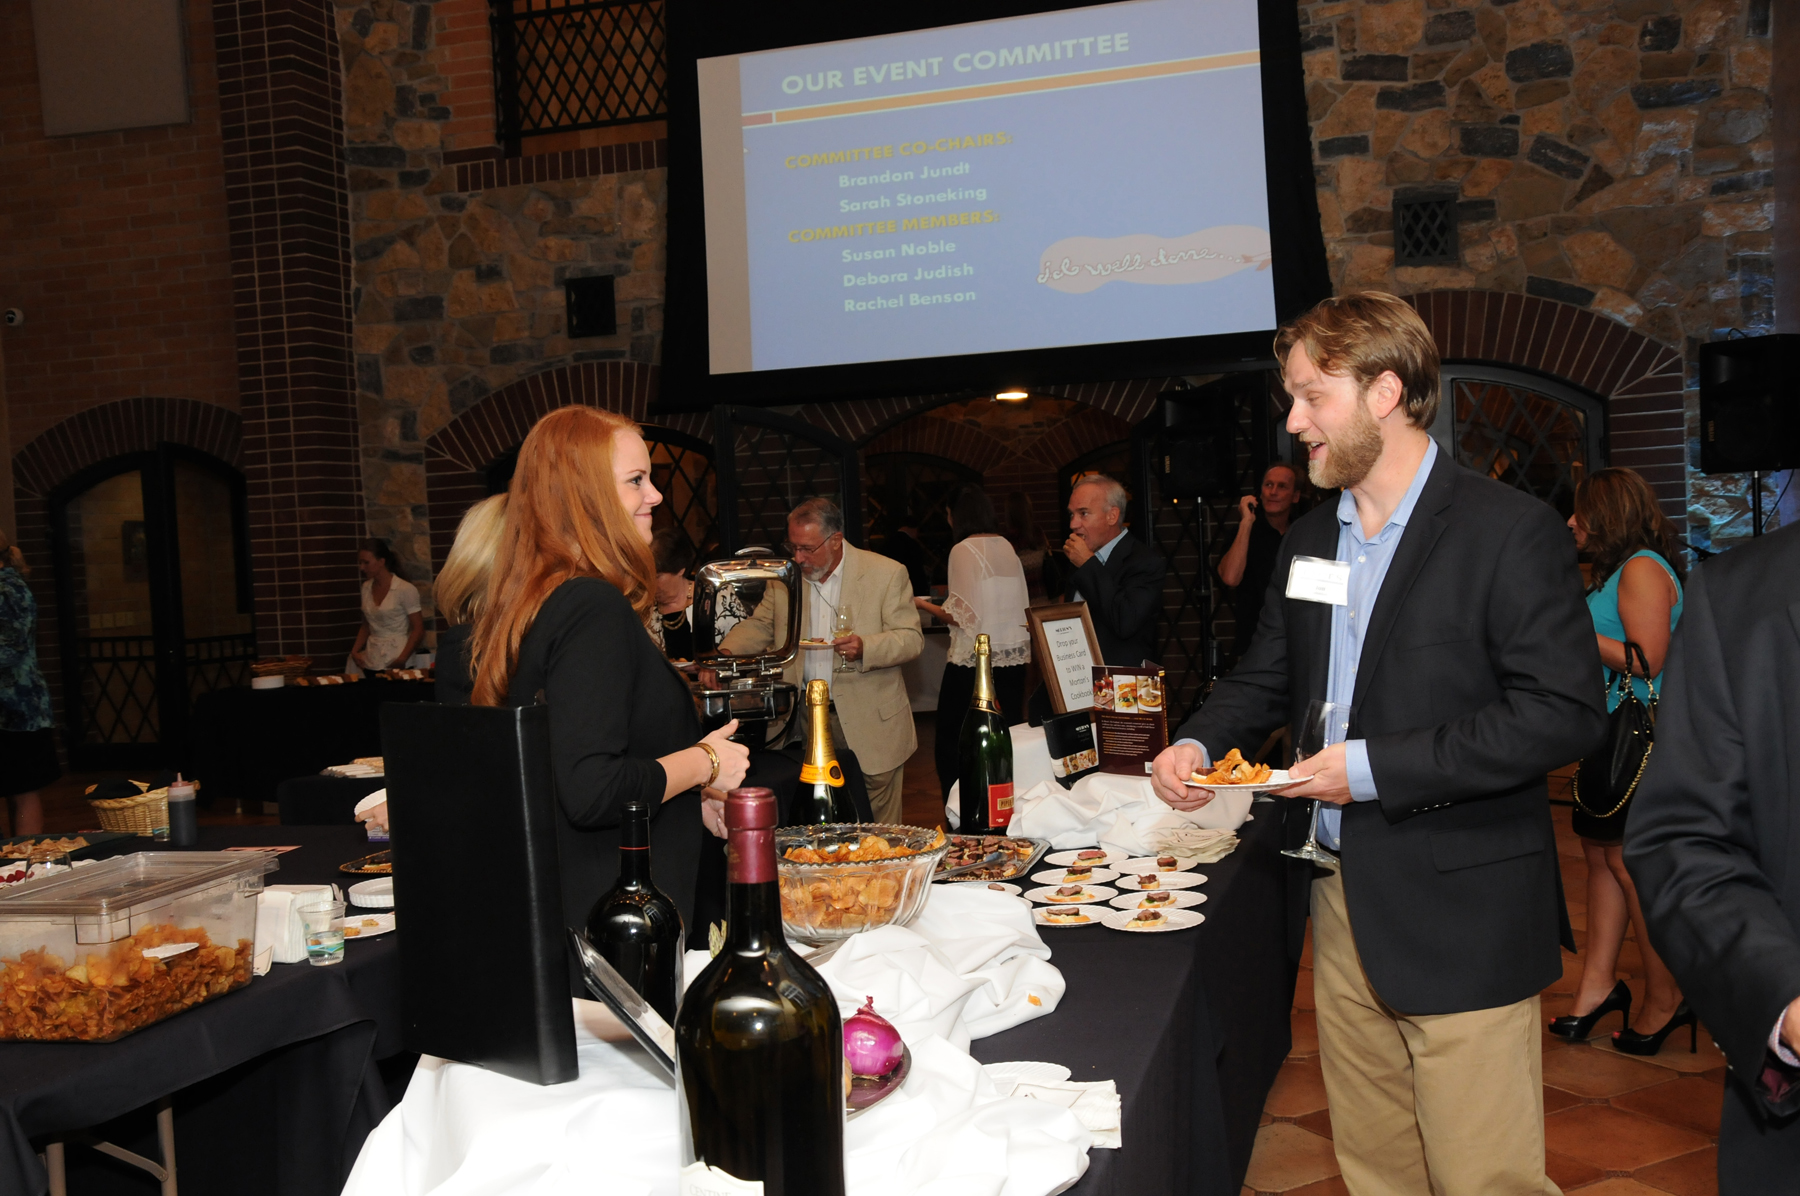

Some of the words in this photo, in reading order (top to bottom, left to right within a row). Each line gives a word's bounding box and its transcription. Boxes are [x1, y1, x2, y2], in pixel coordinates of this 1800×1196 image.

[781, 70, 844, 95] OUR
[853, 57, 944, 86] EVENT
[952, 32, 1131, 73] COMMITTEE
[785, 145, 894, 169] COMMITTEE
[900, 131, 1014, 156] CO-CHAIRS:
[838, 170, 914, 188] Brandon
[920, 162, 971, 180] Jundt
[839, 195, 891, 213] Sarah
[896, 187, 987, 207] Stoneking
[788, 220, 897, 243] COMMITTEE
[902, 209, 1001, 232] MEMBERS:
[842, 248, 896, 263] Susan
[901, 239, 957, 257] Noble
[843, 272, 908, 287] Debora
[913, 263, 974, 281] Judish
[1085, 253, 1144, 276] well
[844, 294, 904, 312] Rachel
[909, 291, 976, 307] Benson
[1056, 640, 1069, 648] Drop
[1069, 638, 1079, 647] your
[1056, 652, 1076, 662] Business
[1076, 649, 1087, 658] Card
[1065, 666, 1071, 674] to
[1071, 664, 1082, 672] WIN
[1069, 676, 1090, 687] Morton's
